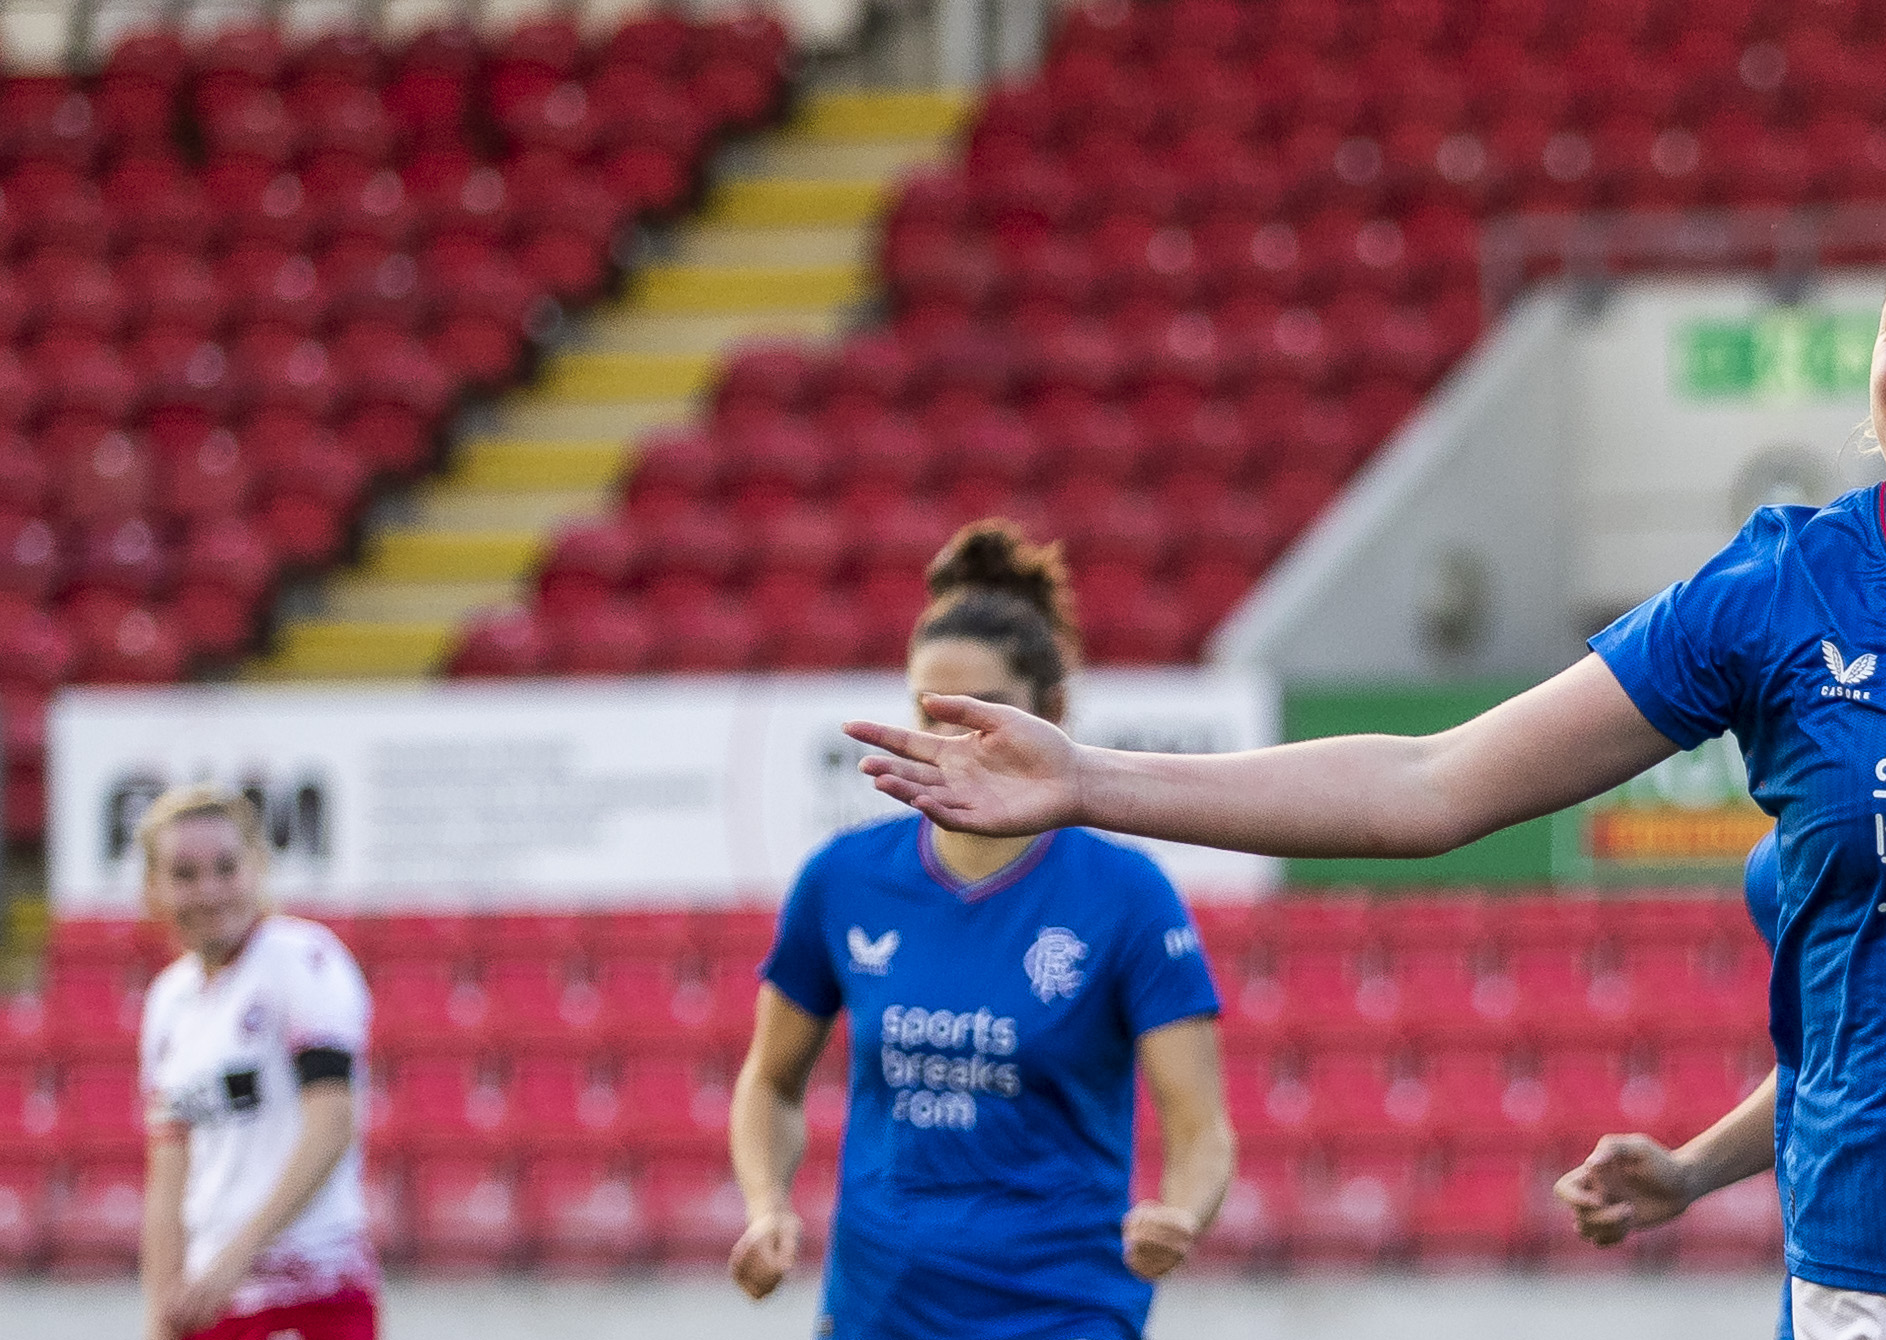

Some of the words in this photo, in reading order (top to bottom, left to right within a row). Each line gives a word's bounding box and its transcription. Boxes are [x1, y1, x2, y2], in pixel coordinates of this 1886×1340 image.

[1821, 685, 1871, 700] CASORE
[881, 1004, 1018, 1056] sports
[881, 1043, 1021, 1098] breaks
